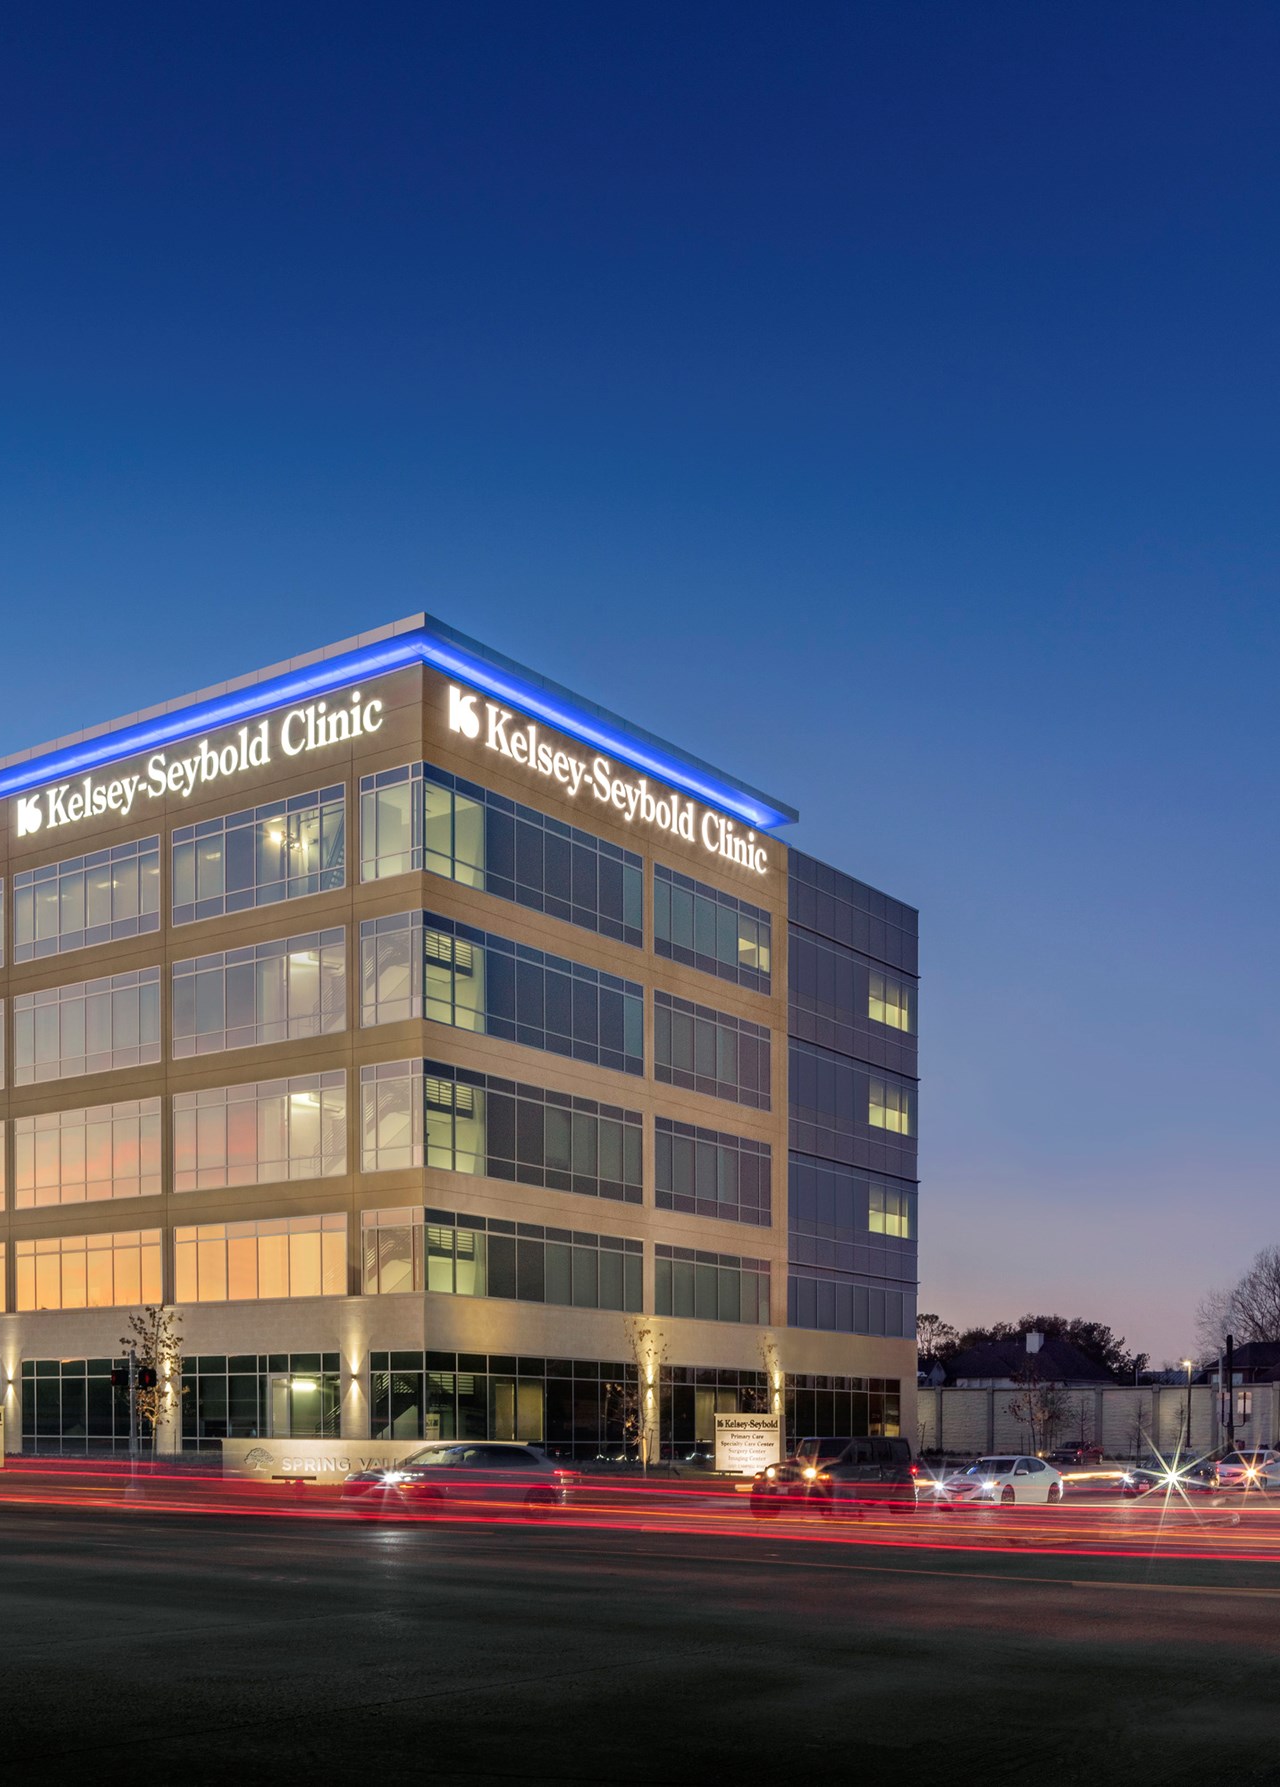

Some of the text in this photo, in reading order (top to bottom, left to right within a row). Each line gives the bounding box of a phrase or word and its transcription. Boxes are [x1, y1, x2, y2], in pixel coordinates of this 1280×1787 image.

[46, 720, 270, 829] Kelsey-Seybold
[280, 691, 383, 756] Clinic
[485, 703, 696, 843] Kelsey-Seybold
[701, 811, 768, 874] Clinic
[725, 1420, 778, 1429] Kelsey-Seybold
[281, 1456, 352, 1472] SPRING
